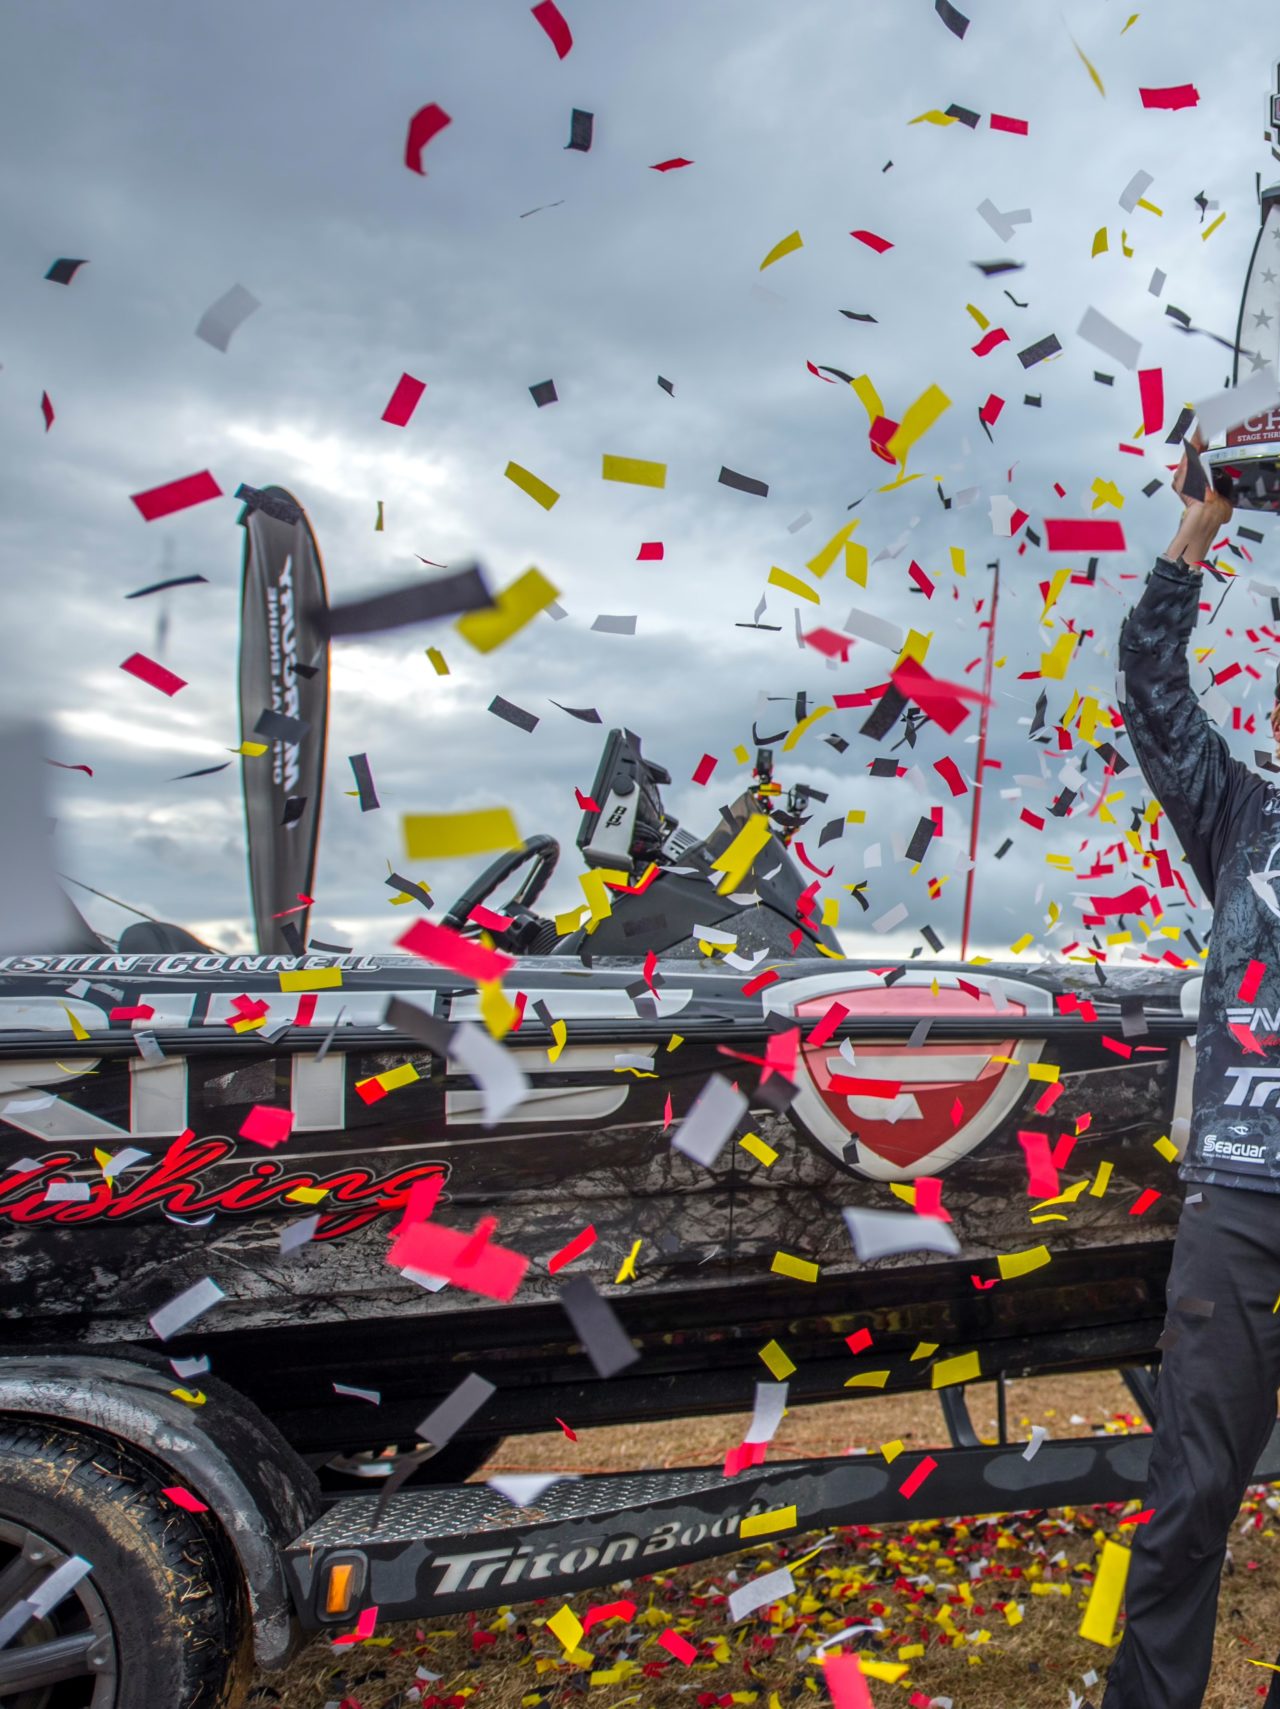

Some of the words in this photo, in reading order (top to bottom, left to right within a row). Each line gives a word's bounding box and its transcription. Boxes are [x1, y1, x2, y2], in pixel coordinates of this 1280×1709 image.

[1237, 433, 1261, 442] STAGE
[156, 954, 380, 974] CONNELL
[431, 1536, 641, 1597] Triton
